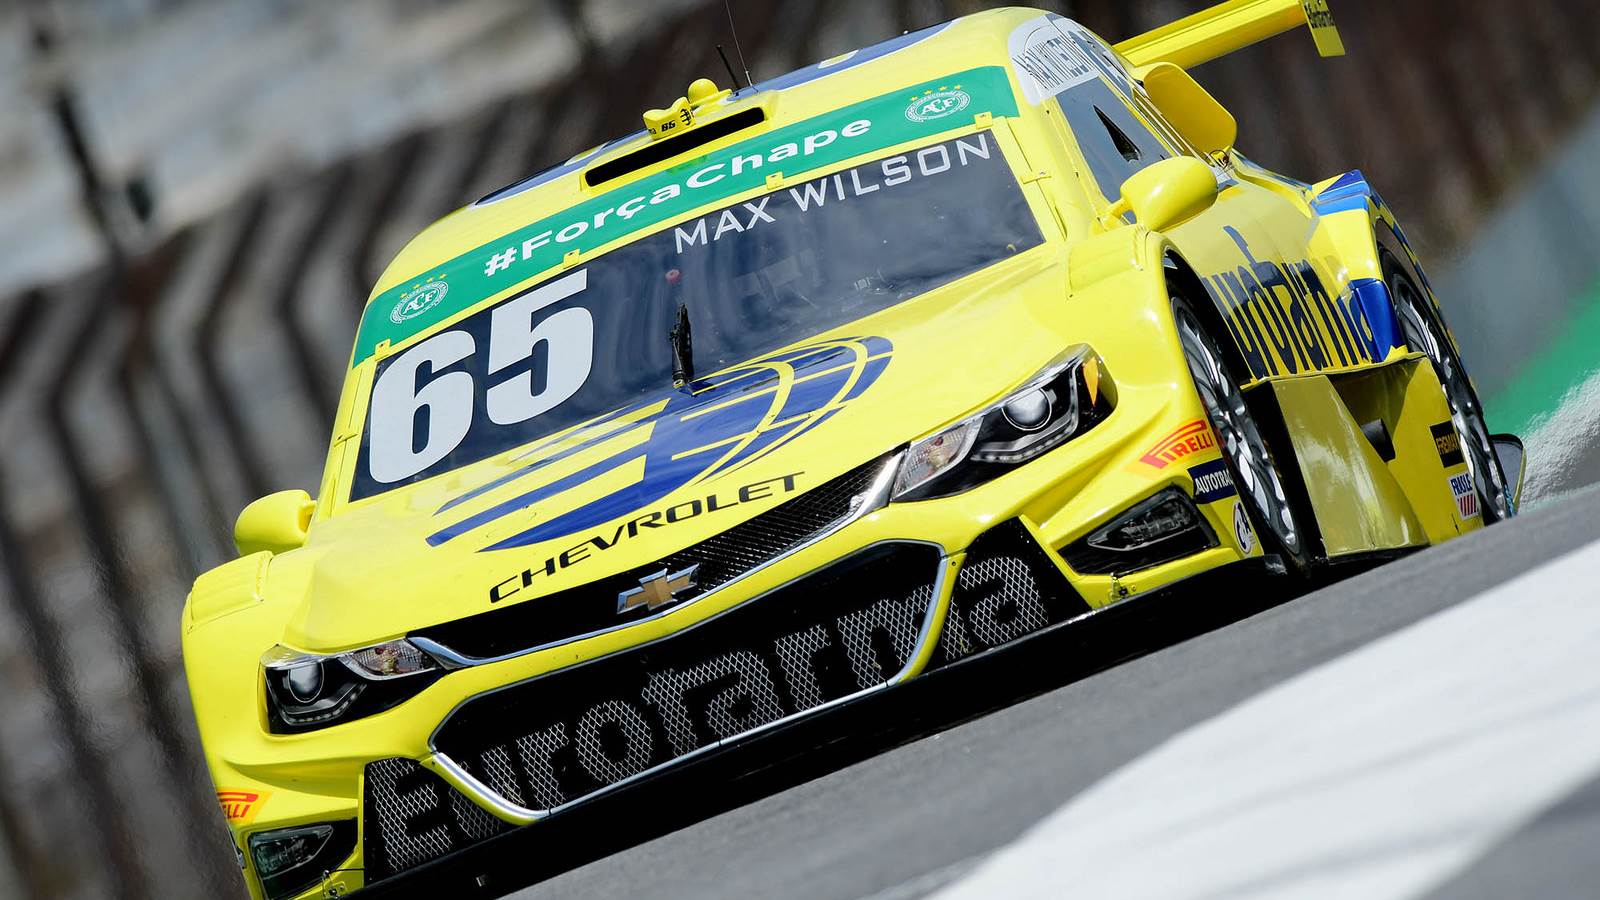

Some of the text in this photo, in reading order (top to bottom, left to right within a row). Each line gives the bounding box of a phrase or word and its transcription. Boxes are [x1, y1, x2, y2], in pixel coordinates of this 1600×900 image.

[483, 118, 872, 279] #ForçaChape
[674, 133, 991, 255] MAX WILSON
[368, 267, 595, 484] 65
[1139, 418, 1215, 470] PIRELLI
[489, 471, 805, 604] CHEVROLET
